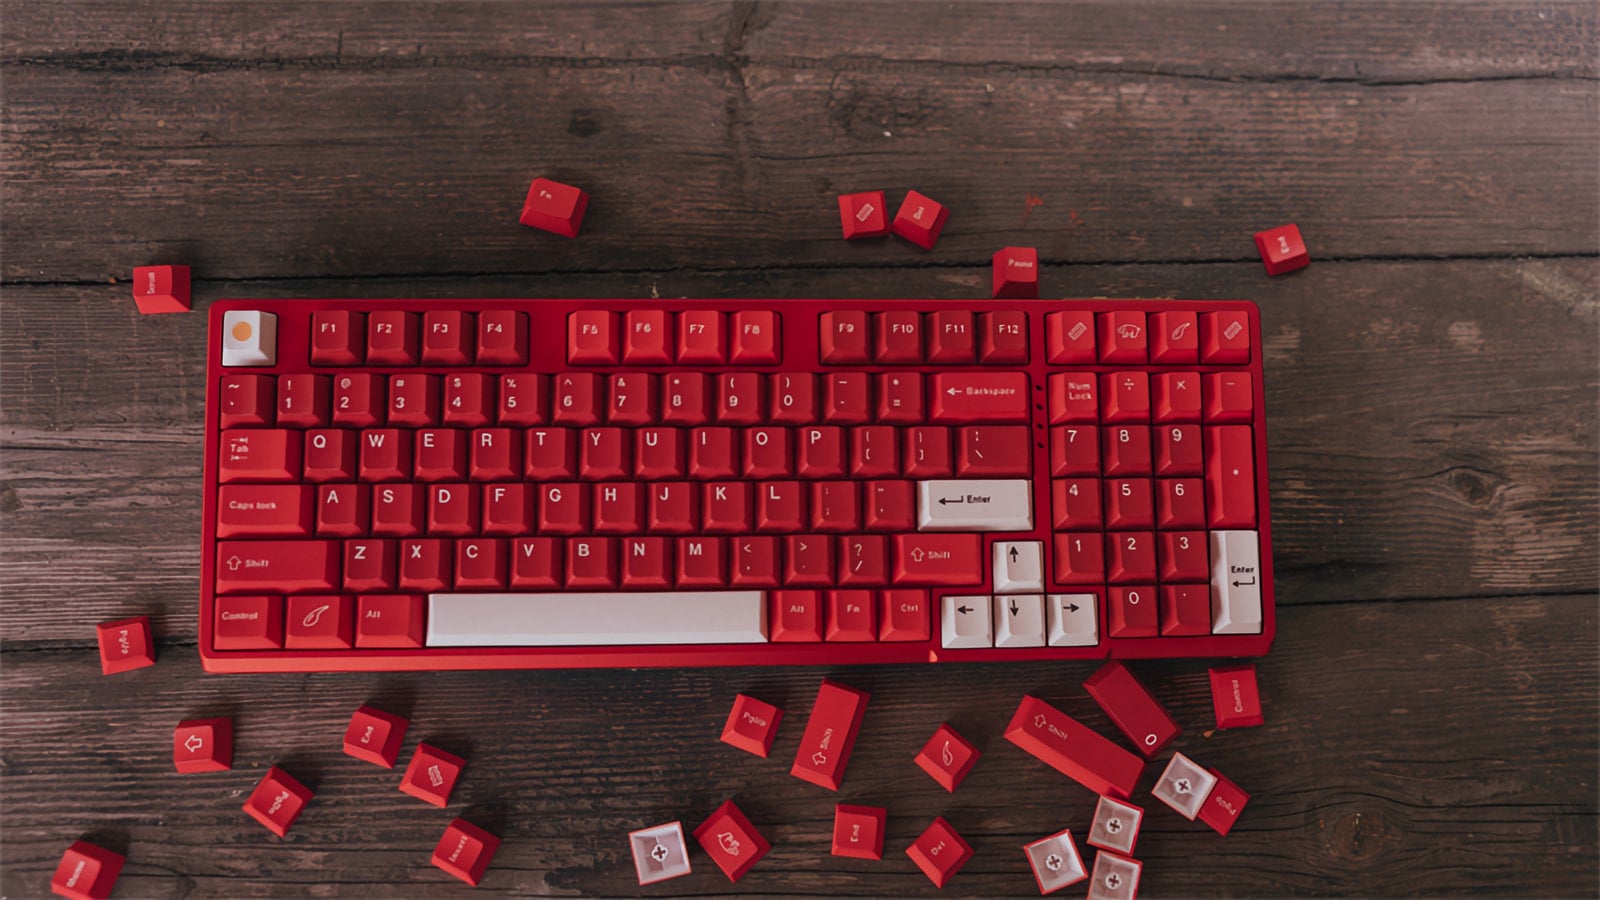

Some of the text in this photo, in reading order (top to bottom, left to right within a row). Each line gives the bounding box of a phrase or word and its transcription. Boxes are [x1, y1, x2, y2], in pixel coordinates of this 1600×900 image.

[321, 322, 336, 333] F1
[376, 323, 393, 334] F2
[433, 323, 449, 334] F3
[487, 323, 503, 333] F4
[635, 322, 652, 333] F6
[689, 323, 705, 334] F7
[744, 324, 761, 335] F8
[838, 322, 855, 333] F9
[892, 323, 914, 334] F10
[945, 323, 965, 334] F11
[998, 324, 1019, 335] F12
[285, 397, 292, 409] 1
[340, 396, 350, 409] 2
[395, 396, 405, 409] 3
[452, 396, 462, 408] 4
[507, 396, 517, 408] 5
[563, 395, 573, 407] 6
[617, 395, 627, 407] 7
[672, 394, 682, 407] 8
[729, 395, 739, 407] 9
[783, 394, 794, 407] 0
[313, 434, 327, 449] Q
[368, 434, 385, 448] W
[423, 433, 435, 448] E
[481, 432, 492, 447] R
[535, 431, 547, 446] T
[590, 432, 601, 446] Y
[646, 432, 658, 447] U
[701, 431, 706, 446] I
[755, 431, 769, 446] O
[810, 430, 822, 445] P
[1067, 429, 1078, 443] 7
[1119, 429, 1130, 443] 8
[1171, 428, 1183, 442] 9
[230, 444, 249, 454] Tab
[326, 489, 339, 504] A
[383, 489, 394, 504] S
[438, 488, 451, 504] D
[494, 487, 506, 503] F
[548, 488, 562, 503] G
[604, 487, 617, 502] H
[659, 486, 669, 501] J
[715, 486, 727, 501] K
[770, 485, 781, 500] L
[1068, 483, 1079, 496] 4
[1121, 483, 1132, 497] 5
[1175, 483, 1185, 496] 6
[228, 500, 255, 511] Caps
[966, 494, 991, 504] Enter
[578, 543, 590, 557] B
[633, 542, 646, 556] N
[689, 542, 703, 556] M
[1075, 539, 1081, 552] 1
[1127, 537, 1137, 551] 2
[1179, 536, 1190, 550] 3
[354, 545, 367, 560] Z
[411, 544, 422, 559] X
[466, 544, 478, 559] C
[523, 543, 535, 558] V
[928, 550, 951, 560] Shift
[1230, 565, 1255, 574] Enter
[1128, 591, 1140, 605] 0
[846, 603, 861, 613] Fn
[900, 603, 919, 613] Ctrl
[850, 824, 860, 843] End
